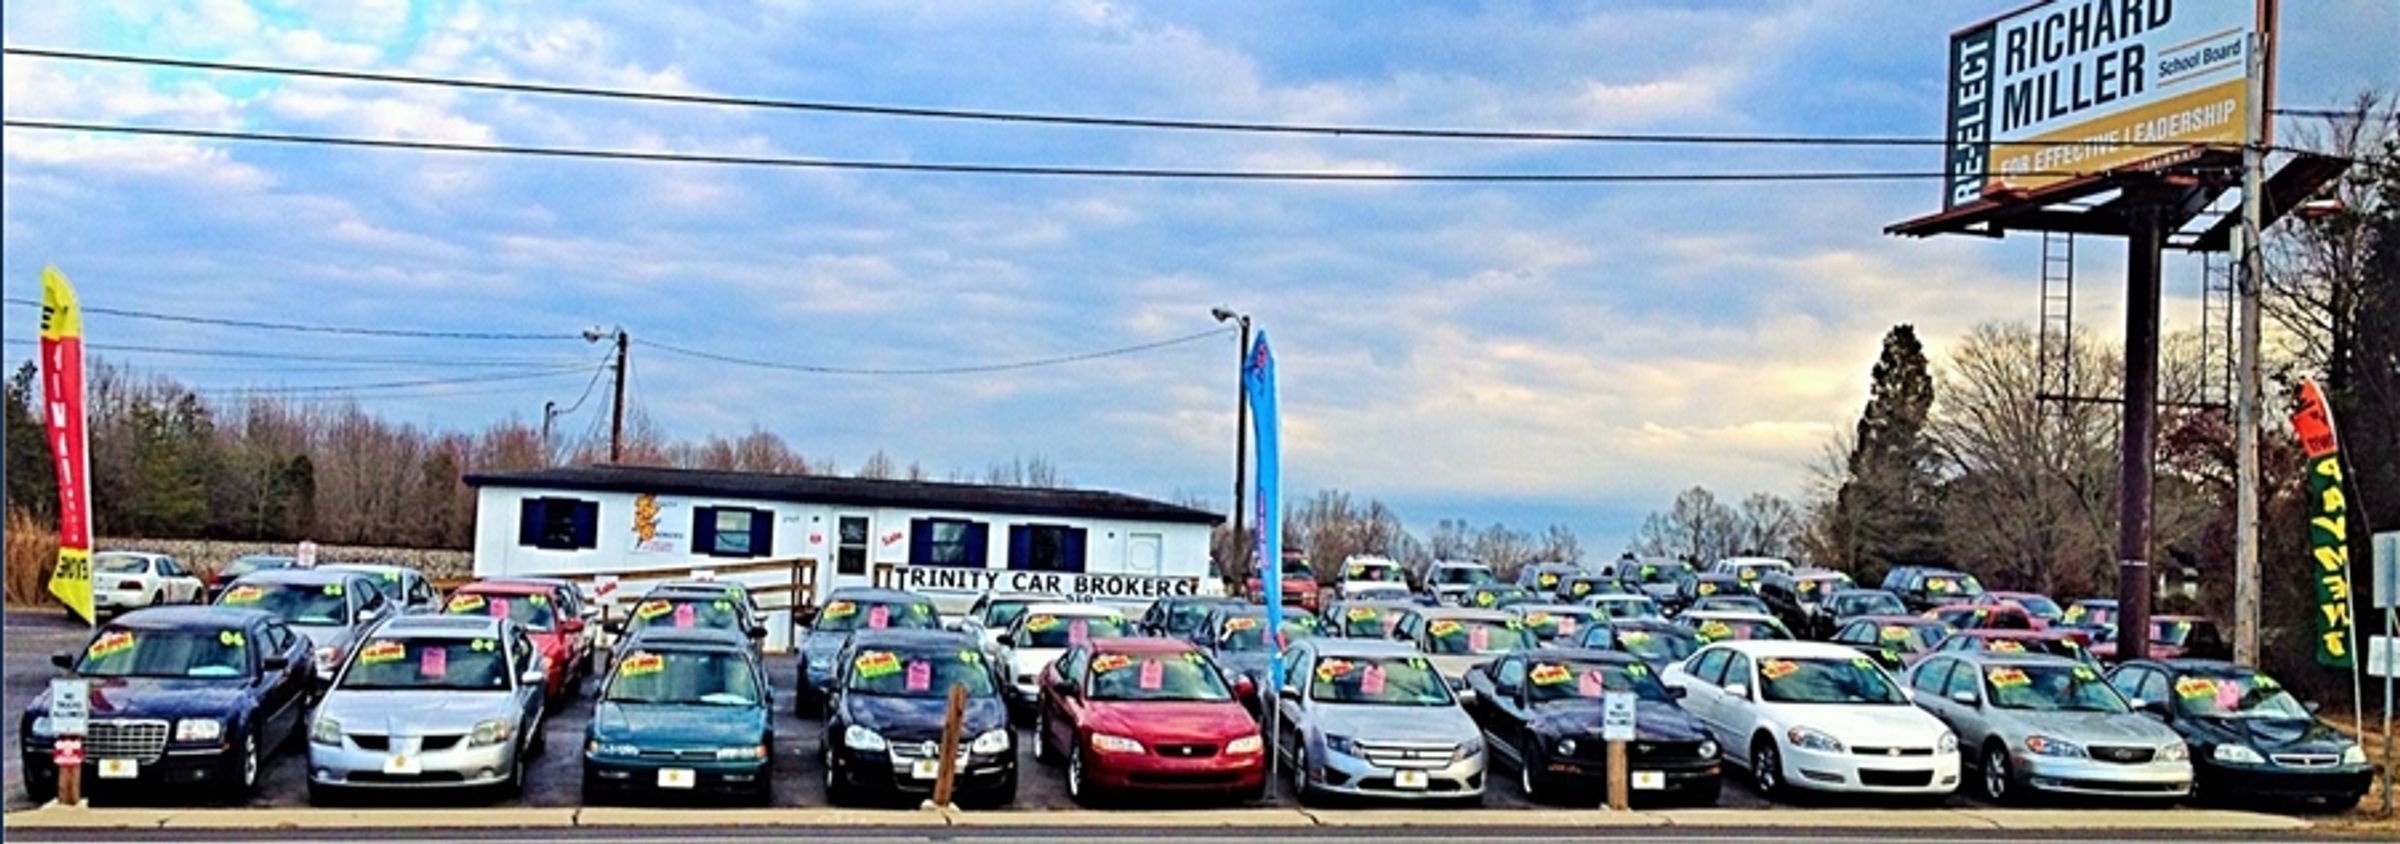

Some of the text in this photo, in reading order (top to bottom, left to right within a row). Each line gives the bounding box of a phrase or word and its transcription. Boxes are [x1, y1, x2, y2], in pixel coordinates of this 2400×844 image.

[2001, 44, 2146, 132] MILLER
[2158, 39, 2241, 78] School Board
[1954, 40, 1990, 206] RE-ELECT
[2034, 129, 2120, 171] EFFECTIVE
[2123, 98, 2237, 146] LEADERSHIP
[895, 566, 999, 592] TRINITY
[1012, 573, 1061, 593] CAR
